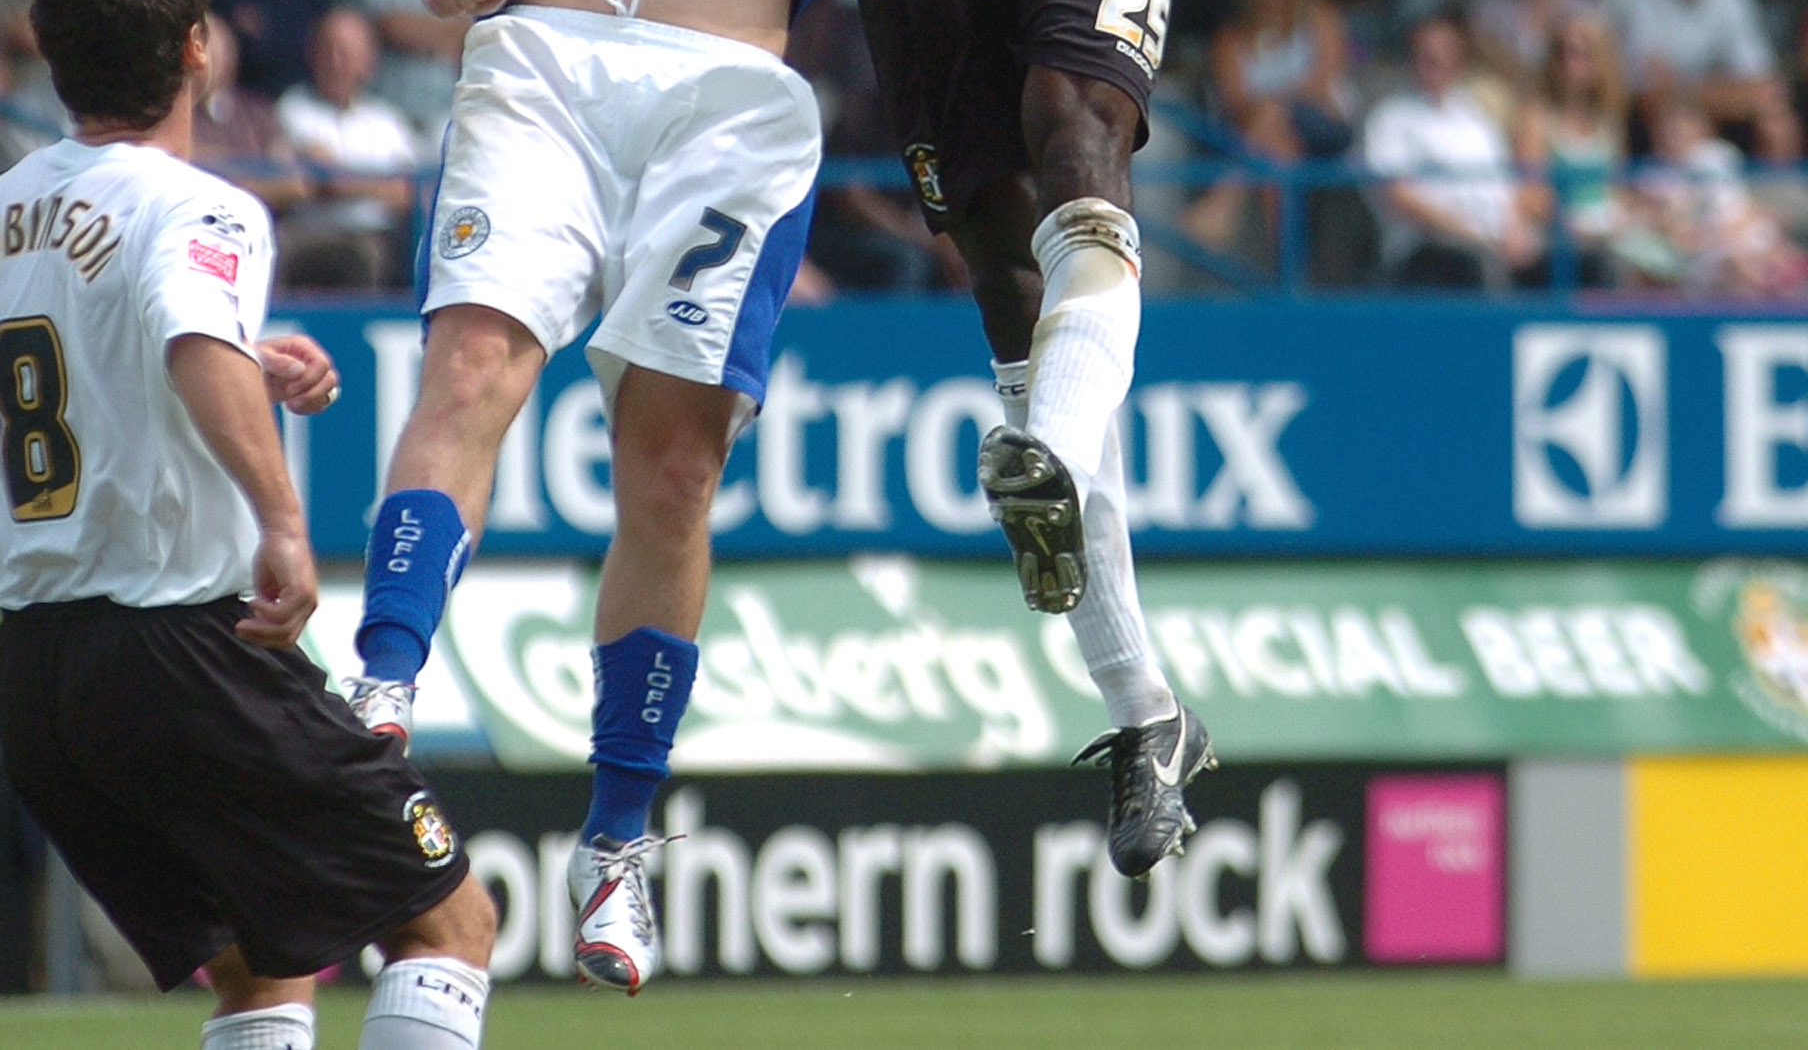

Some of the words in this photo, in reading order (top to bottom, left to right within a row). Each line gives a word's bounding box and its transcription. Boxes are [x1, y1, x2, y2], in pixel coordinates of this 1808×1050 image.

[667, 205, 748, 293] 7
[0, 314, 82, 522] 8
[1458, 604, 1712, 698] BEER
[1032, 776, 1348, 971] rock
